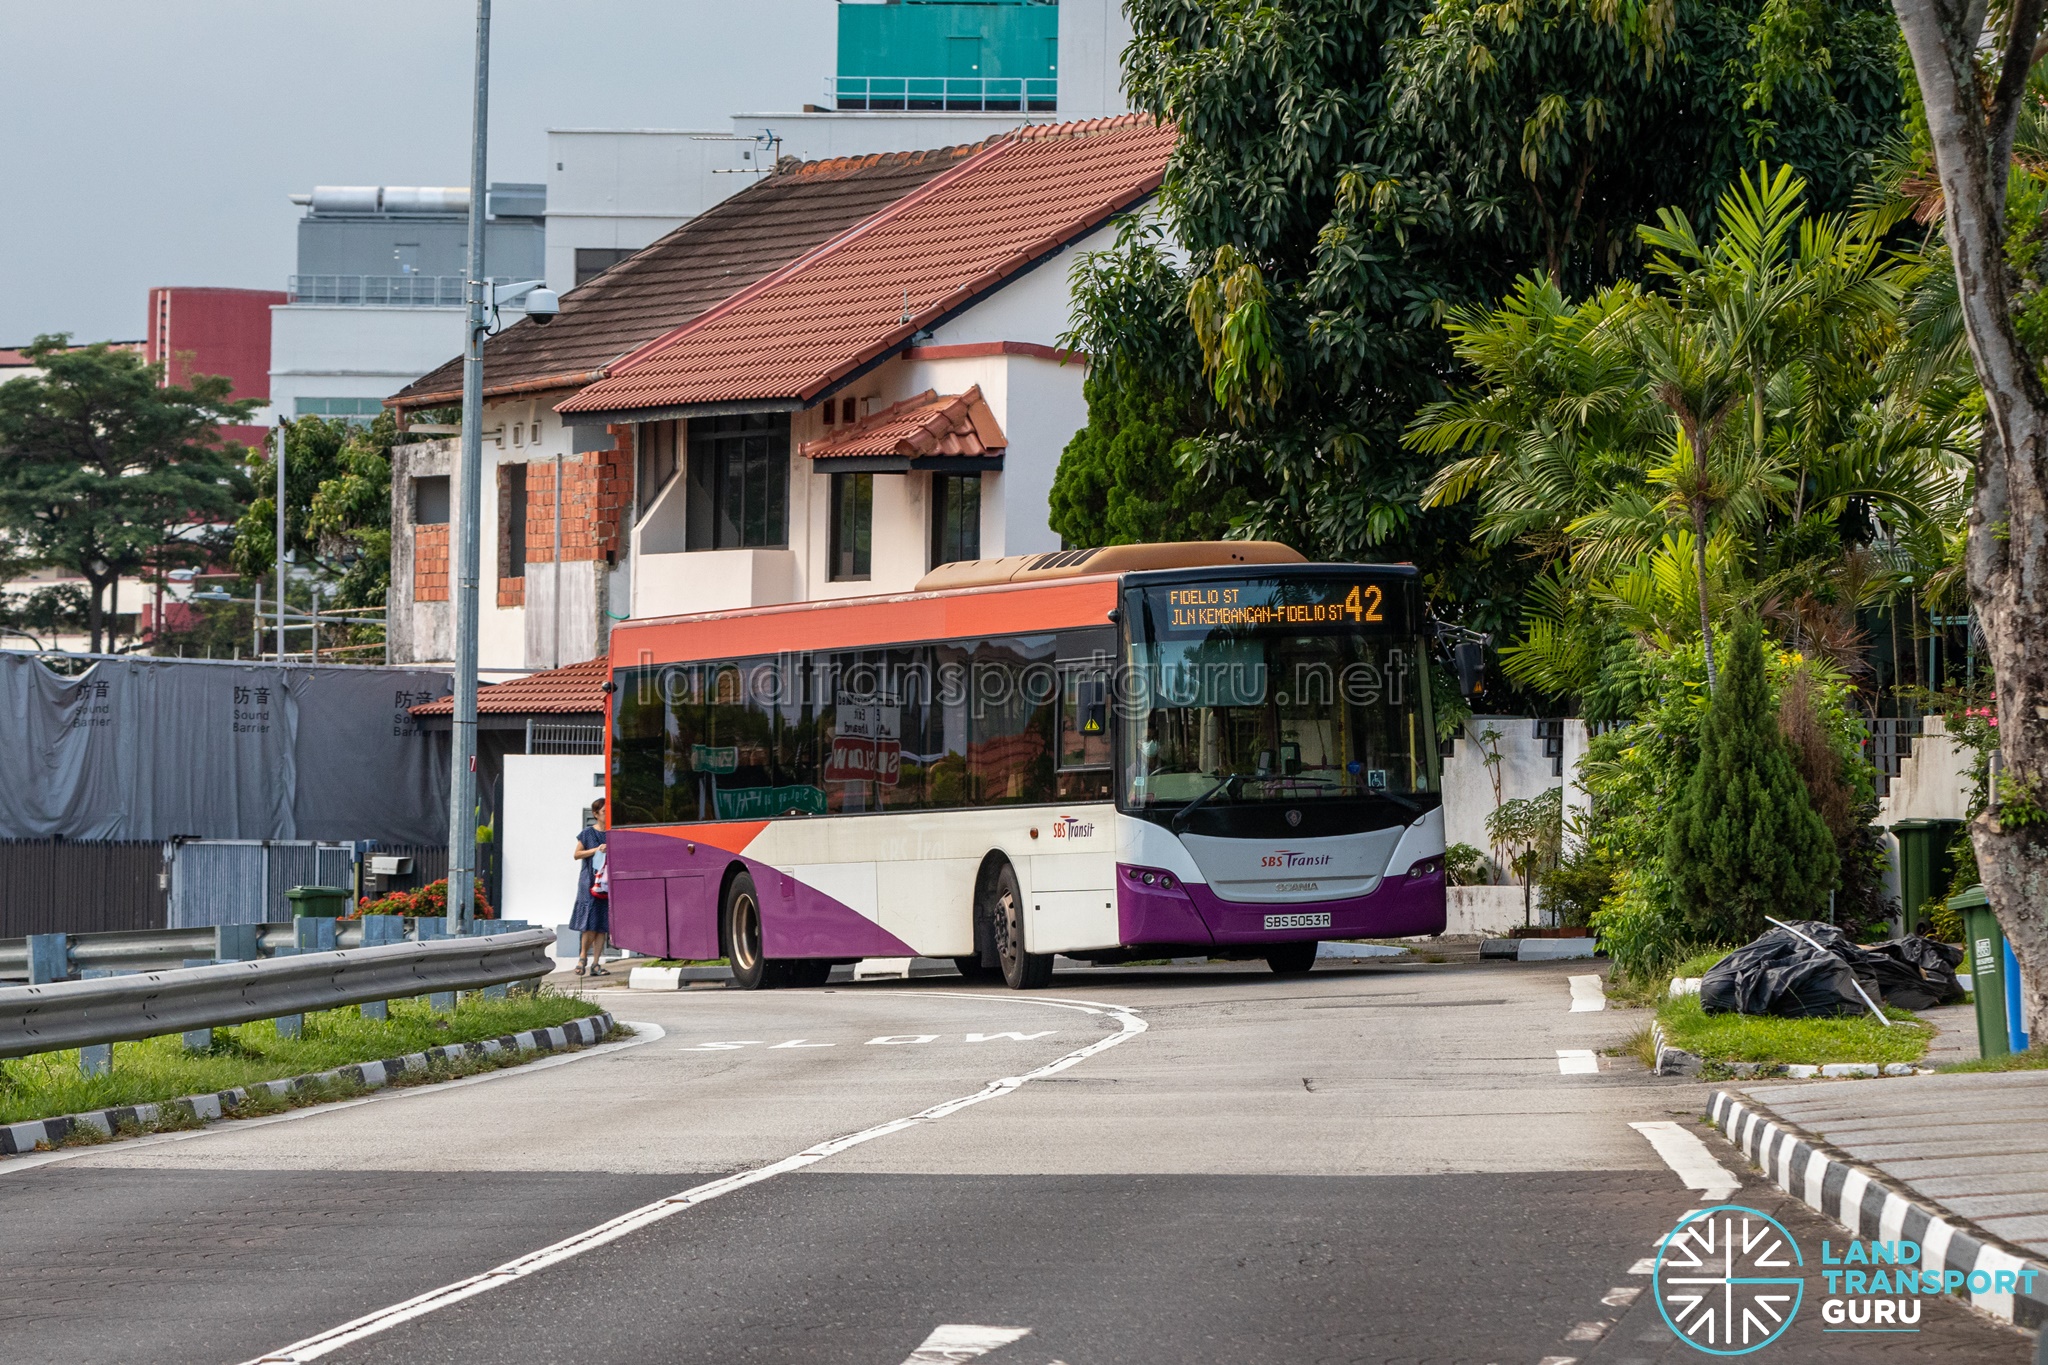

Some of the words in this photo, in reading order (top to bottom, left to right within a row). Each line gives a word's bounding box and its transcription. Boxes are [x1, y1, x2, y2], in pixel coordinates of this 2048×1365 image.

[1170, 590, 1219, 605] FIDELIO
[1223, 589, 1239, 604] ST
[1345, 585, 1383, 622] 42
[1171, 608, 1196, 625] JLN
[1199, 604, 1326, 625] KEMBANGAN-FIDELIO
[1328, 604, 1345, 621] ST
[76, 680, 110, 701] 防音
[234, 686, 271, 705] 防音
[76, 704, 110, 714] Sound
[234, 709, 270, 721] Sound
[73, 717, 111, 728] Barrier
[233, 722, 270, 733] Barrier
[1053, 822, 1066, 838] SBS
[1064, 818, 1095, 842] Transit
[1261, 855, 1283, 868] SBS
[1281, 851, 1334, 869] Transit
[1275, 882, 1319, 892] SCANIA
[679, 1031, 1059, 1051] SLOW
